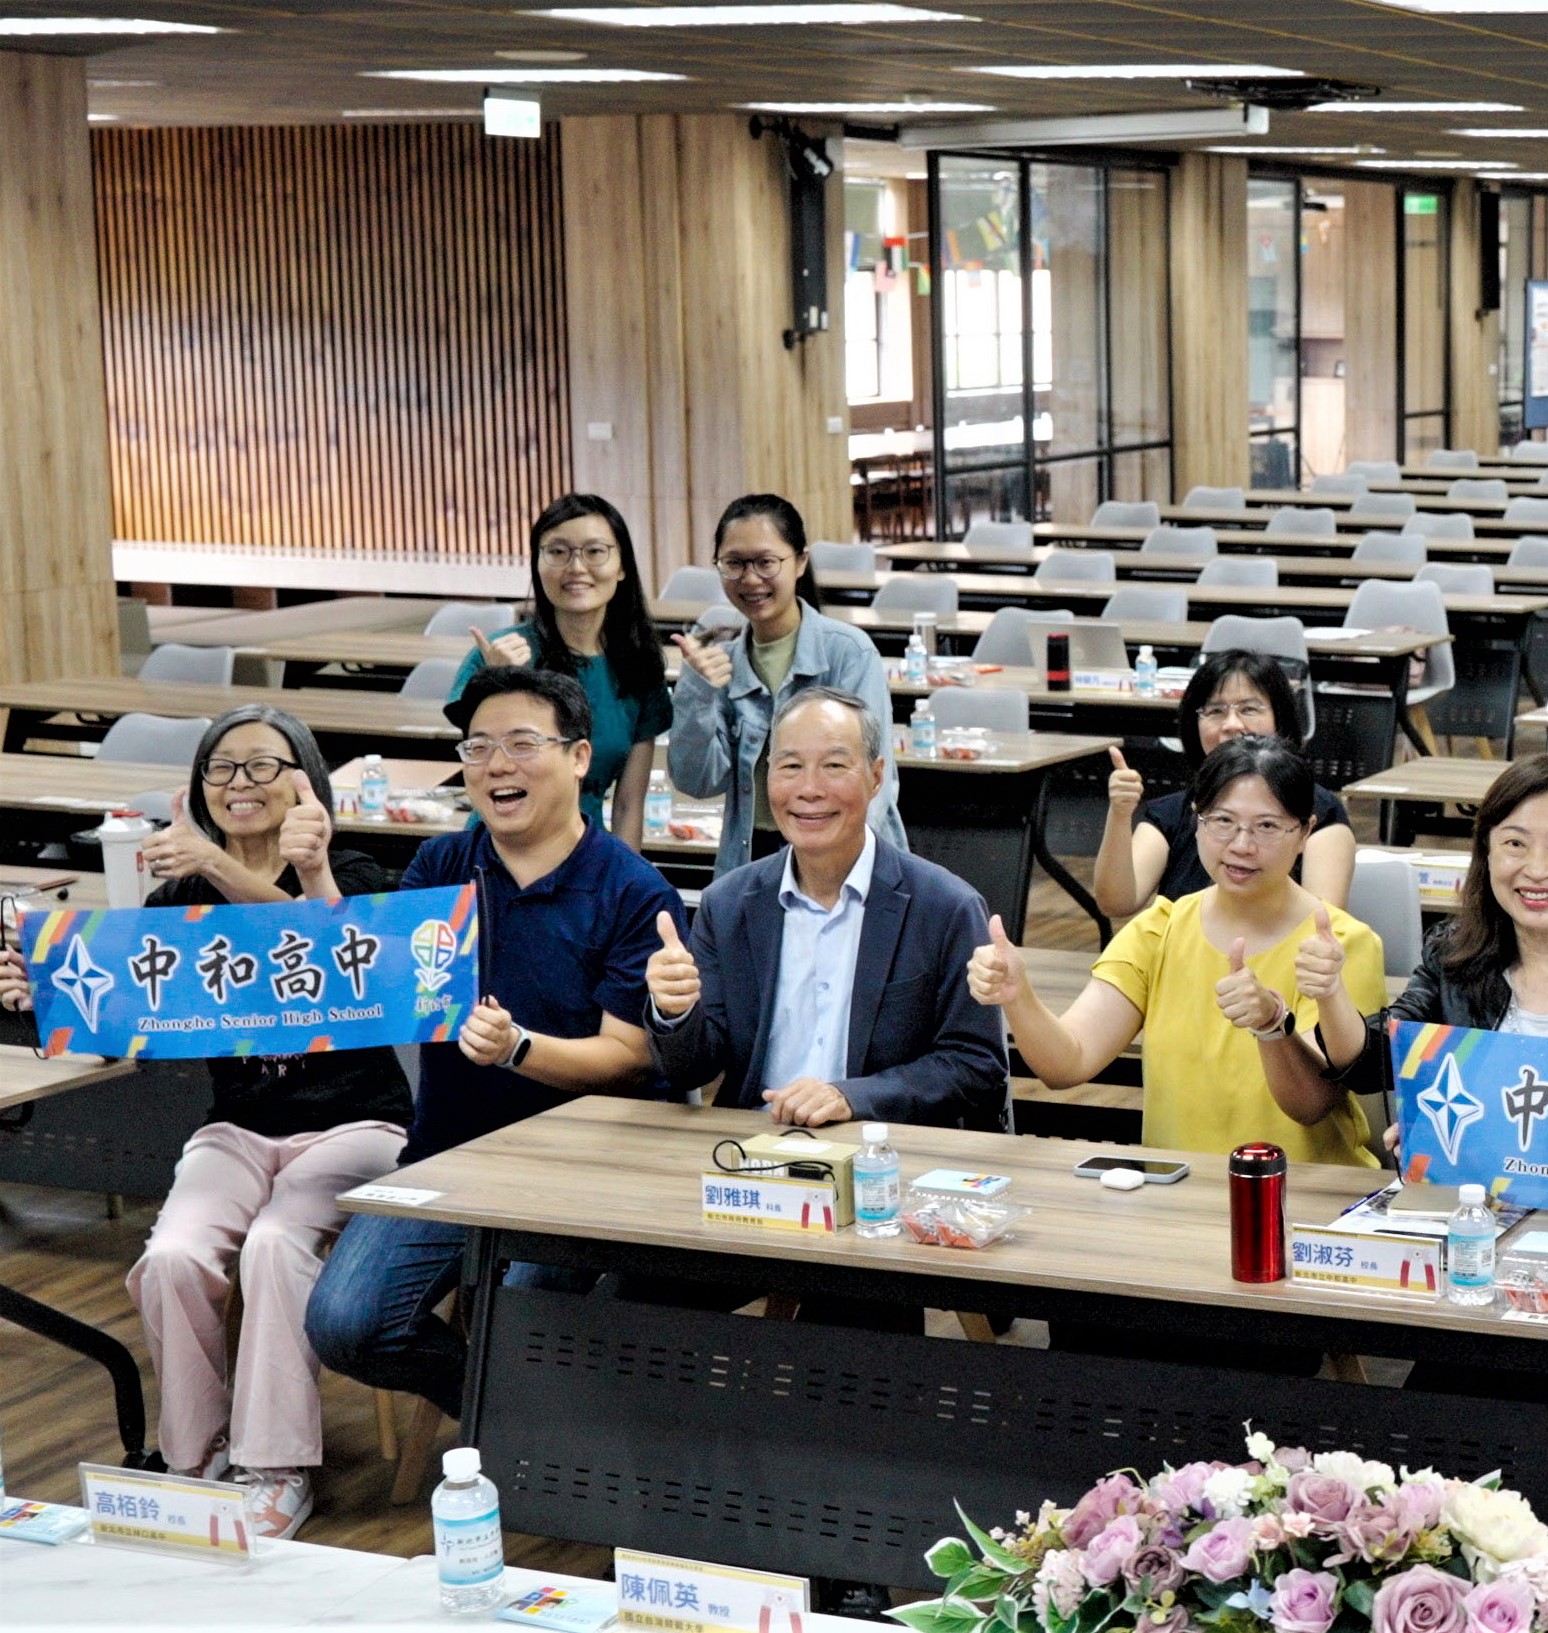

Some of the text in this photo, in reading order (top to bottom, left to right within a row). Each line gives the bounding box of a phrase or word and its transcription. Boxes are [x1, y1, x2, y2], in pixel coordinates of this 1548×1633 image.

[131, 924, 379, 1009] 中和高中
[139, 1005, 382, 1031] Zhonghe Senior High School
[705, 1185, 761, 1210] 劉雅琪
[1293, 1241, 1354, 1268] 劉淑芬
[621, 1572, 700, 1613] 陳佩英
